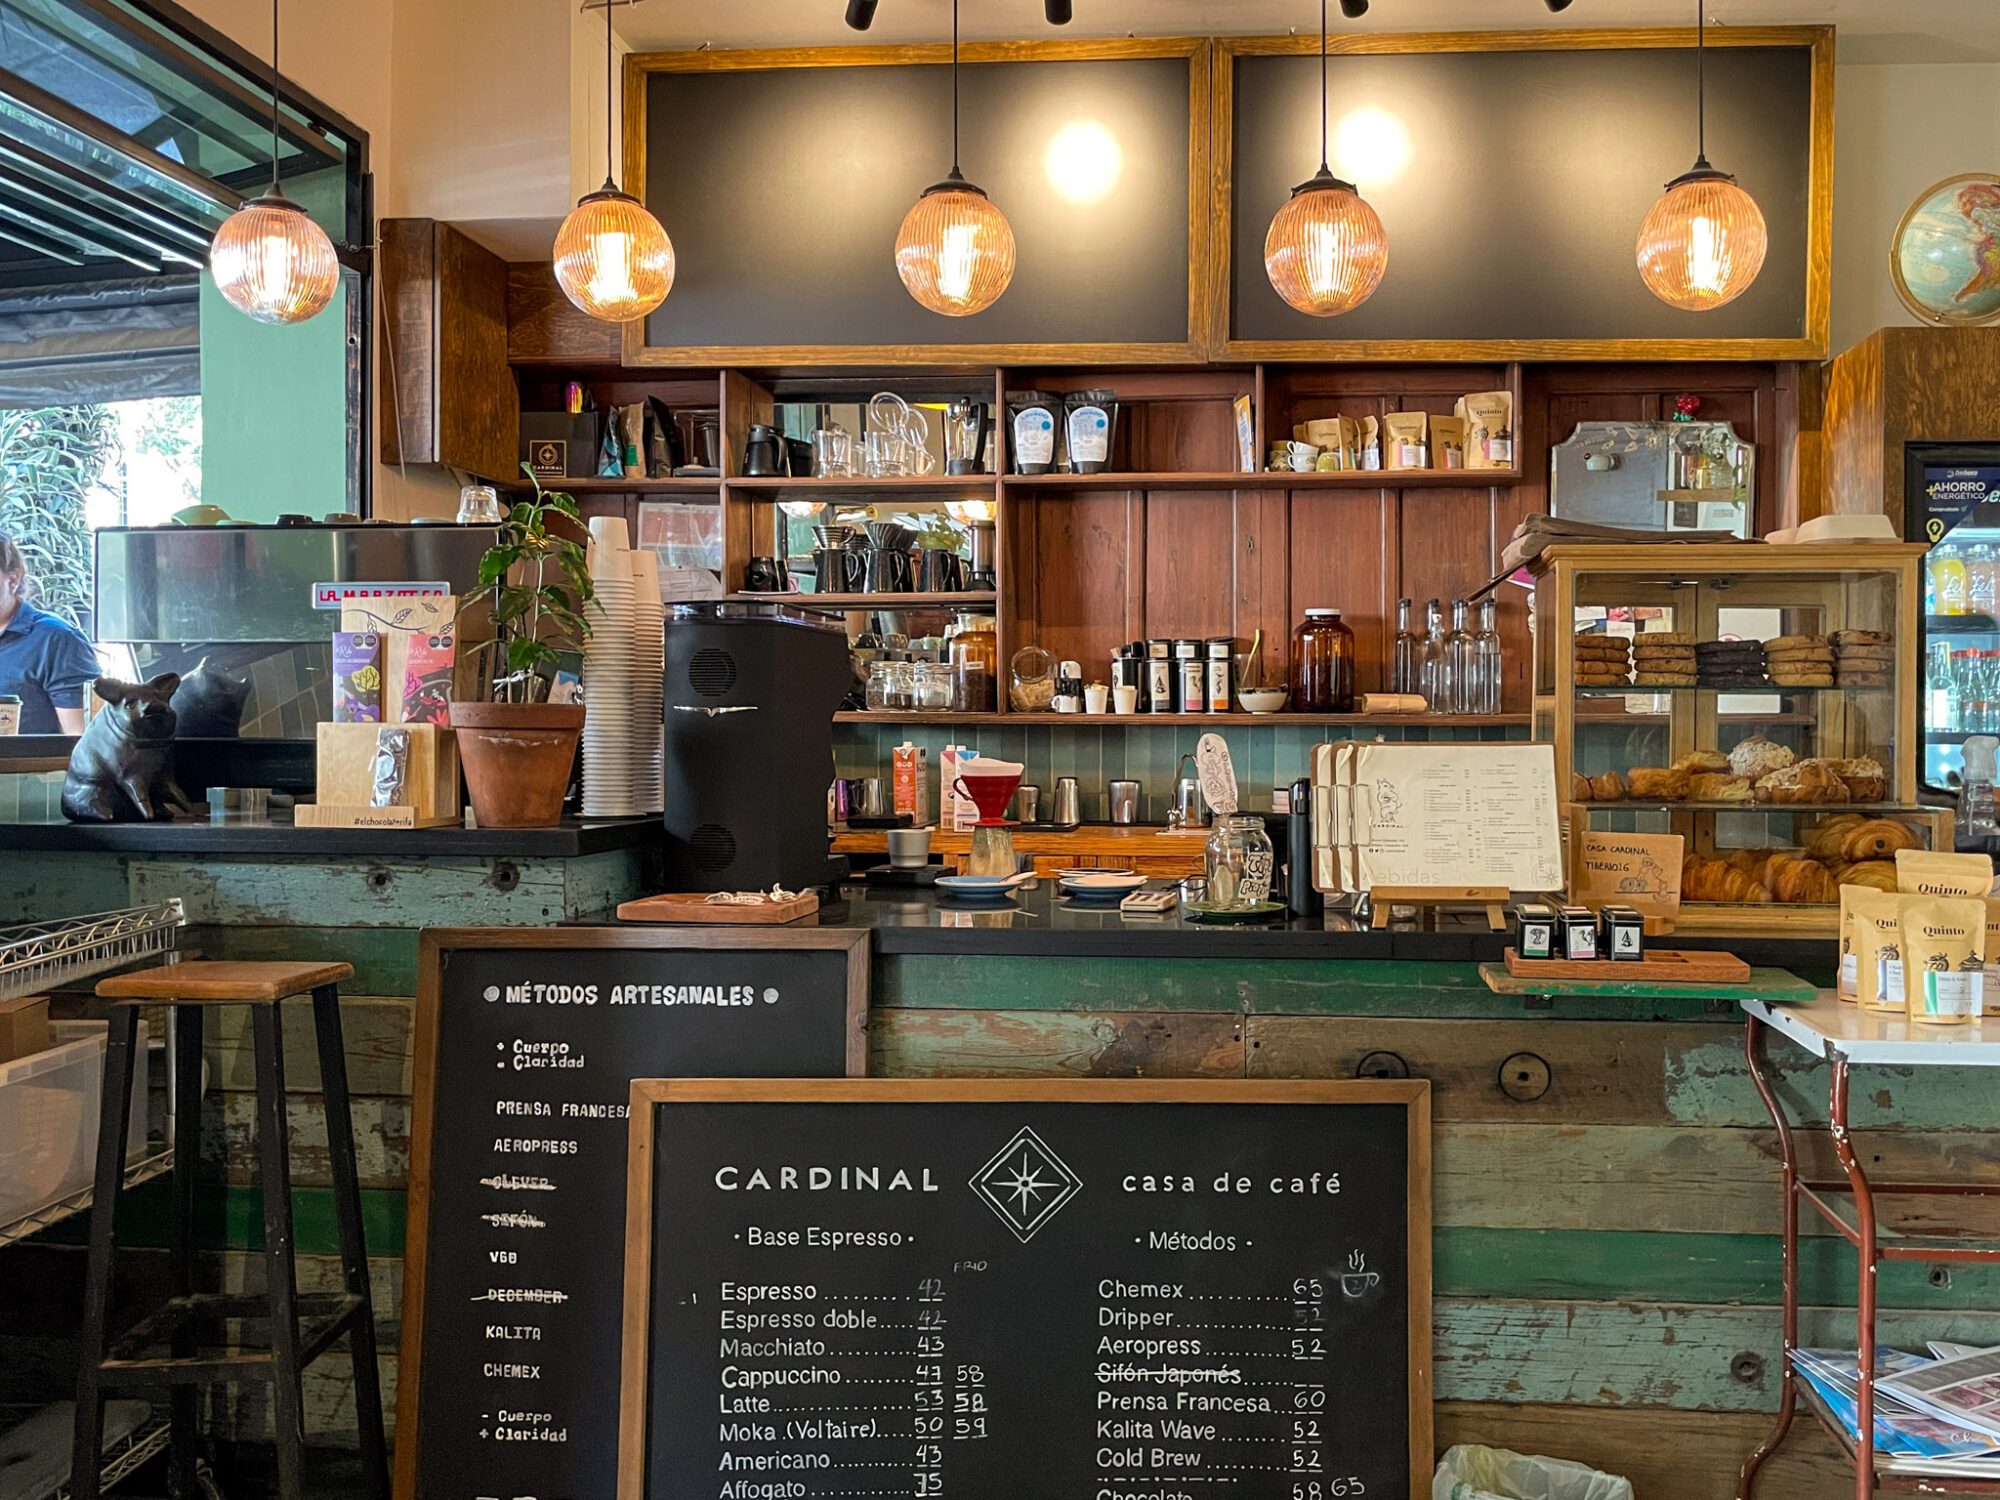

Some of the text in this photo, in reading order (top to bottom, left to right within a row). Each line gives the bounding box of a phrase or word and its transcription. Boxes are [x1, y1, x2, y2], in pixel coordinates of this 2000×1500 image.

[1932, 491, 1986, 500] ENERGÉTICO
[319, 590, 341, 602] LA
[1586, 845, 1650, 856] CASA CARDINAL
[1376, 867, 1441, 884] ebidas
[1918, 883, 1968, 896] Quinto
[1876, 918, 1898, 930] Qui
[1923, 926, 1965, 938] Quinto
[506, 981, 753, 1006] MÉTODOS ARTESANALES
[513, 1039, 570, 1056] Cuerpo
[513, 1055, 585, 1071] Claridad
[497, 1101, 551, 1115] PRENSA
[494, 1139, 577, 1154] AEROPRESS
[716, 1167, 938, 1191] CARDINAL
[1123, 1172, 1340, 1193] casa de café
[749, 1227, 901, 1251] Base Espresso
[1150, 1231, 1235, 1251] Métodos
[722, 1278, 946, 1305] Espresso 42
[1099, 1278, 1323, 1299] Chemex 65
[721, 1309, 947, 1332] Espresso doble 42
[1099, 1307, 1173, 1330] Dripper
[486, 1326, 540, 1340] KALITA
[721, 1336, 945, 1358] Macchiato 43
[1097, 1336, 1327, 1359] Aeropress 52
[484, 1364, 540, 1379] CHEMEX
[722, 1366, 840, 1389] Cappuccino
[955, 1365, 985, 1381] 58
[1097, 1363, 1242, 1387] Sifón Japonés
[720, 1391, 985, 1413] Latte 53 58
[1098, 1391, 1326, 1412] Prensa Francesa 60
[499, 1410, 551, 1424] Cuerpo
[496, 1427, 566, 1441] Claridad
[720, 1417, 986, 1441] Moka (Voltaire) 50 59
[1098, 1420, 1321, 1440] Kalita Wave 52
[719, 1444, 943, 1470] Americano 43
[1097, 1448, 1322, 1467] Cold Brew 52
[720, 1481, 805, 1500] Affogato
[1293, 1482, 1323, 1500] 58
[1331, 1477, 1366, 1496] 65
